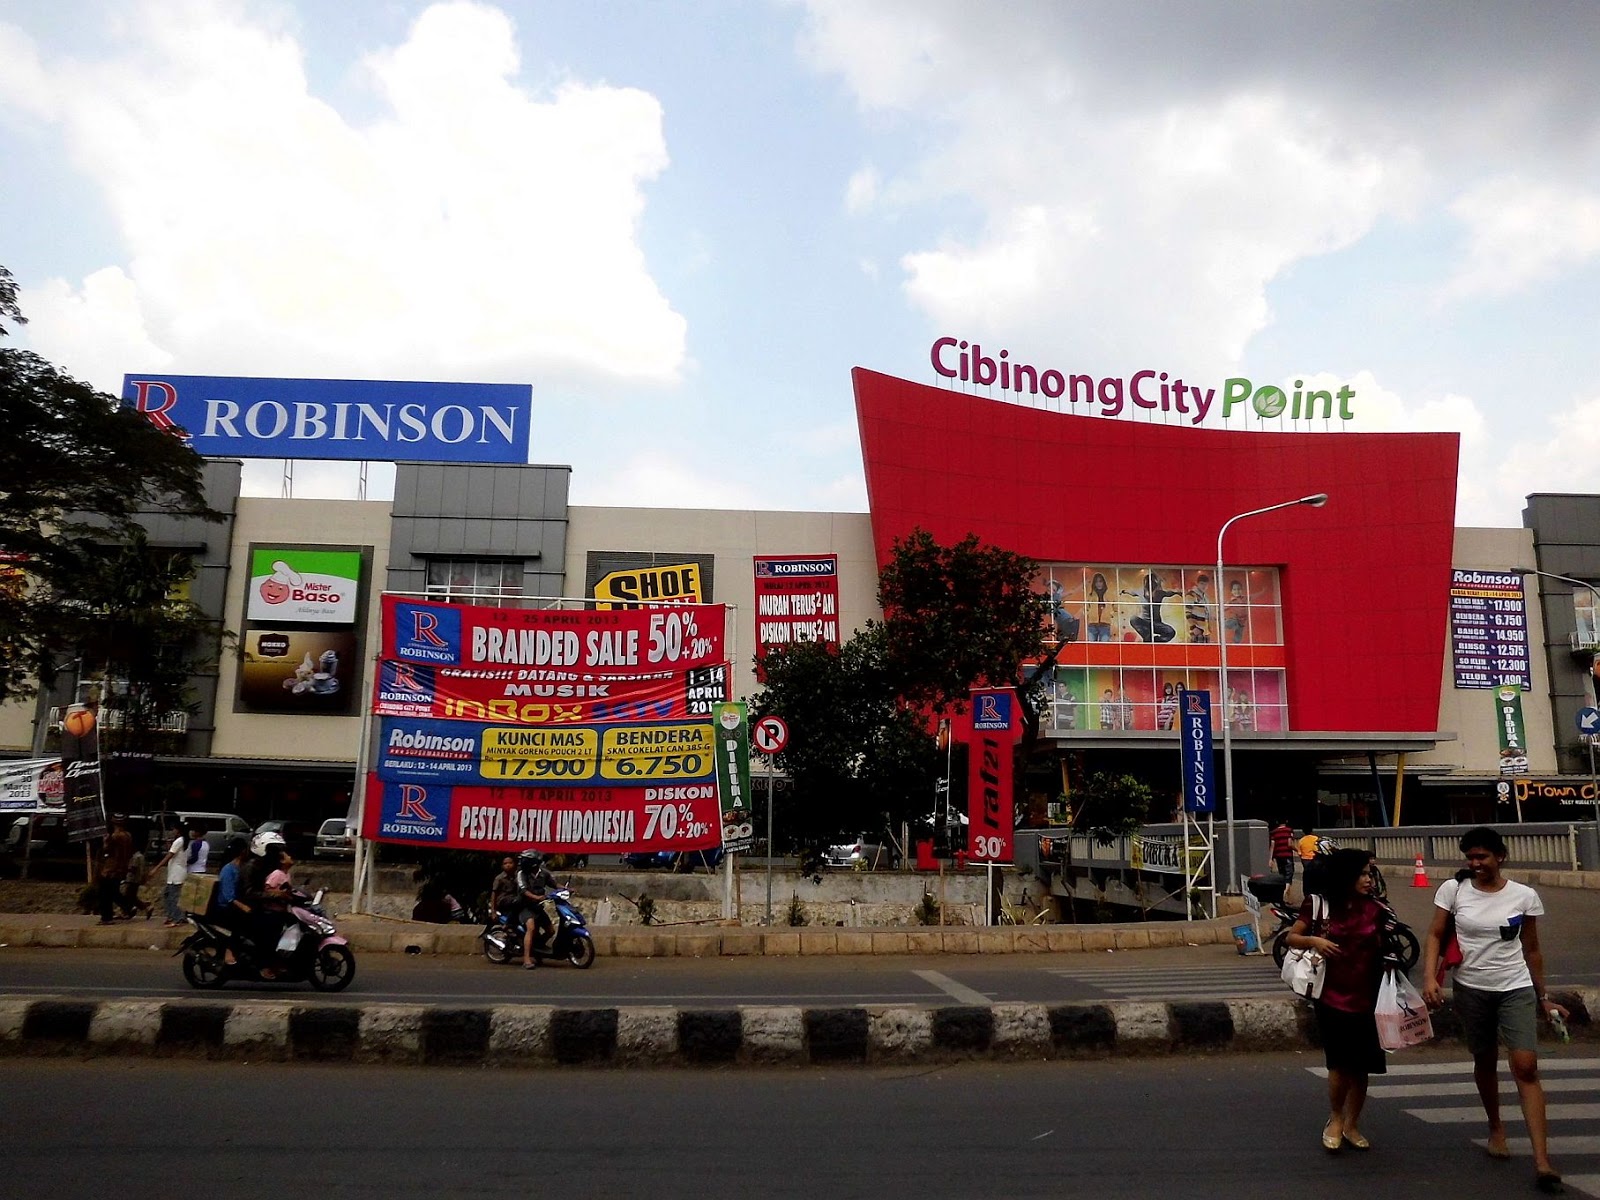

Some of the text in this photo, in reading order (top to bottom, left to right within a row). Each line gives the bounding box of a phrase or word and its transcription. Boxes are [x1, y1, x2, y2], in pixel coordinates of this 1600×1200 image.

[1222, 377, 1355, 421] Point
[201, 399, 519, 444] ROBINSON
[774, 563, 832, 573] ROBINSON
[1454, 570, 1520, 585] Robinson
[304, 582, 332, 591] Mister
[609, 568, 695, 609] SHOE
[292, 589, 341, 603] Baso
[760, 594, 790, 616] MURAH
[1494, 600, 1522, 612] 17.900
[524, 614, 538, 624] 25
[544, 615, 581, 624] APRIL
[587, 615, 619, 625] 2013
[1495, 614, 1522, 626] 6.750
[410, 610, 448, 647] R
[760, 622, 790, 644] DISKON
[1496, 630, 1524, 642] 14.950
[648, 611, 698, 663] 50%
[400, 647, 454, 661] ROBINSON
[472, 626, 639, 667] BRANDED SALE
[1497, 644, 1524, 656] 12.575
[1497, 660, 1526, 671] 12.300
[440, 668, 512, 680] GRATIS!!!
[517, 669, 578, 682] DATANG
[710, 668, 724, 683] 14
[1460, 672, 1487, 680] TELUR
[1498, 674, 1522, 686] 1.490
[380, 692, 432, 702] ROBINSON
[504, 683, 610, 697] MUSIK
[688, 686, 724, 700] APRIL
[592, 698, 675, 719] SCTV
[980, 696, 1002, 717] R
[1187, 694, 1206, 711] R
[1503, 706, 1518, 747] DIBUKA
[389, 728, 476, 752] Robinson
[498, 732, 584, 746] KUNCI MAS
[616, 728, 703, 746] BENDERA
[764, 724, 780, 746] P
[404, 750, 453, 758] SUPERMARKET
[628, 746, 664, 754] COKELAT
[666, 745, 684, 753] CAN
[686, 744, 702, 752] 385
[438, 763, 456, 771] APRIL
[456, 764, 472, 772] 2013
[497, 758, 586, 776] 17.900
[616, 754, 702, 776] 6.750
[1192, 718, 1206, 807] ROBINSON
[538, 790, 576, 802] APRIL
[581, 790, 612, 802] 2013
[644, 786, 714, 801] DISKON
[1515, 780, 1577, 801] J-Town
[396, 784, 436, 822] R
[459, 806, 635, 843] PESTA BATIK INDONESIA
[642, 802, 694, 840] 70%
[382, 823, 444, 836] ROBINSON
[974, 835, 1006, 858] 30%
